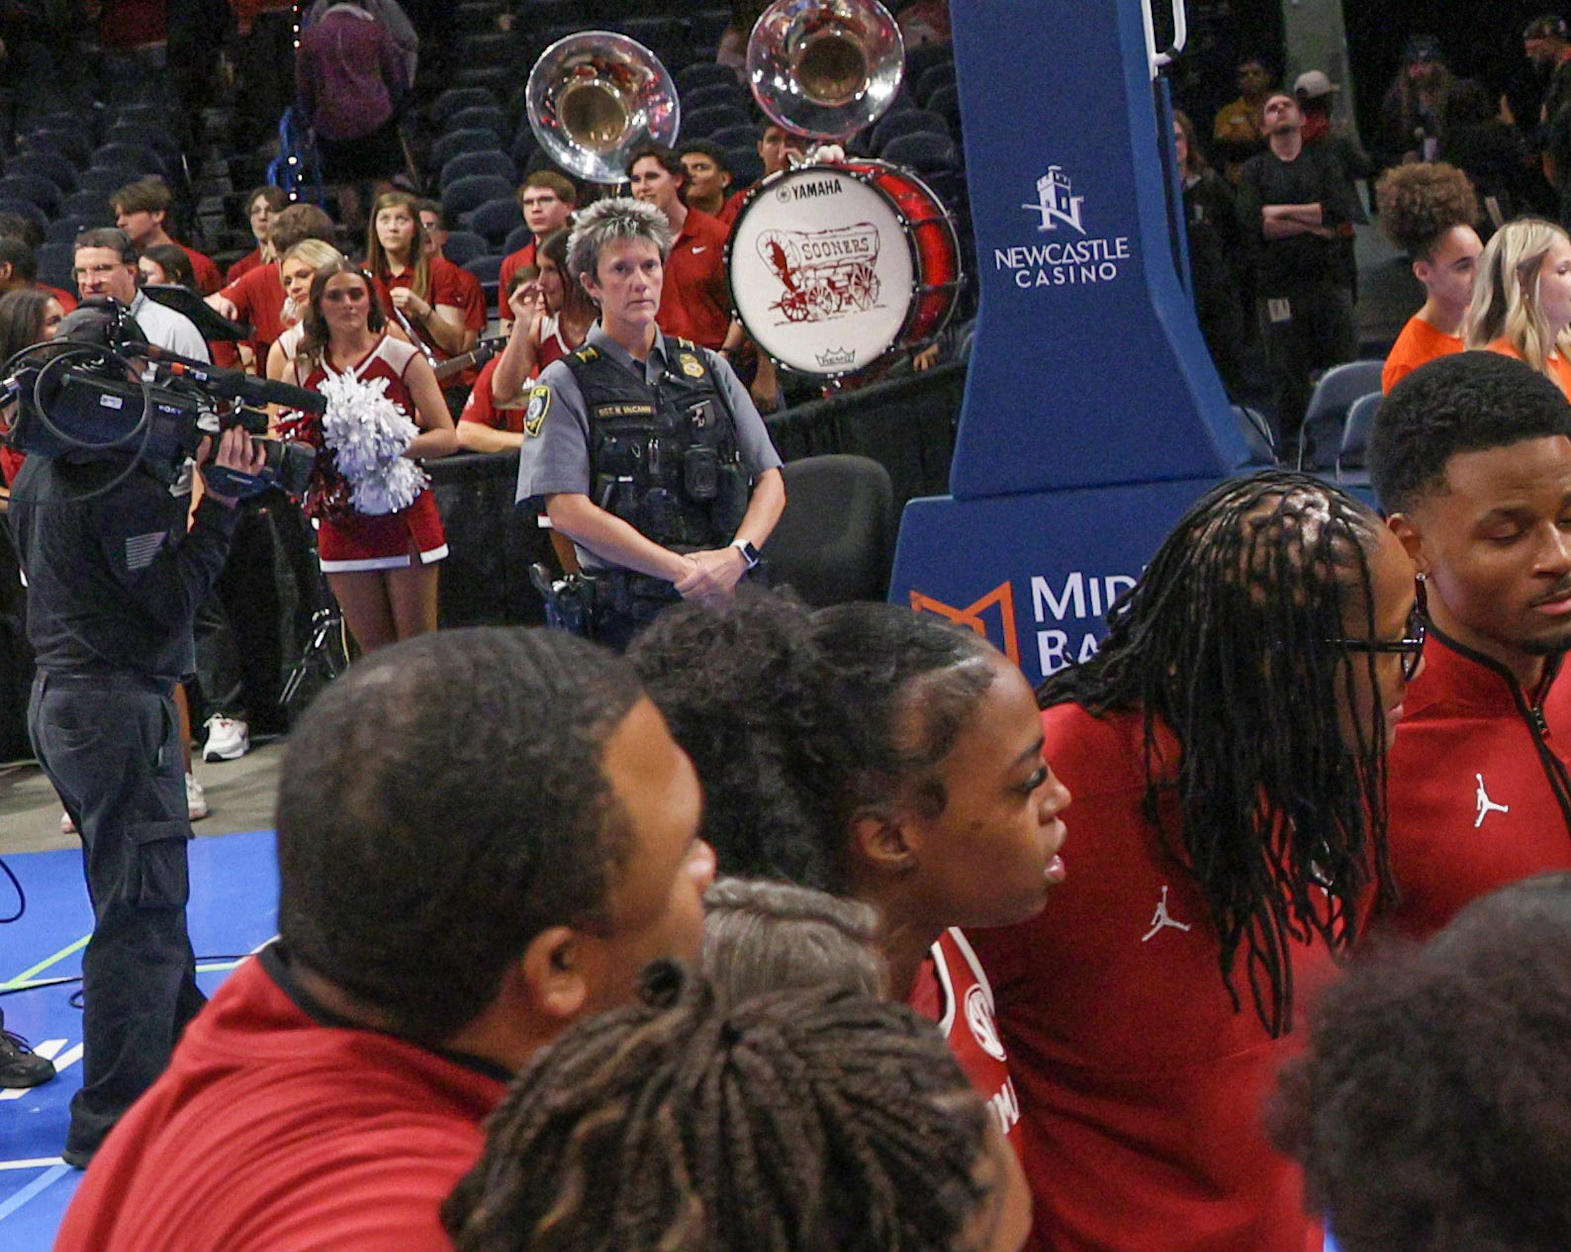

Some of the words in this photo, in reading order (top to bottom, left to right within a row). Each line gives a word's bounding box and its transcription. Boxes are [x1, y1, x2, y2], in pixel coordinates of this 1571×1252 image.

[791, 178, 843, 201] YAMAHA
[801, 236, 870, 261] SOONERS
[995, 237, 1130, 270] NEWCASTLE
[1015, 261, 1117, 288] CASINO
[1031, 571, 1137, 622] MID
[1036, 629, 1099, 677] BA
